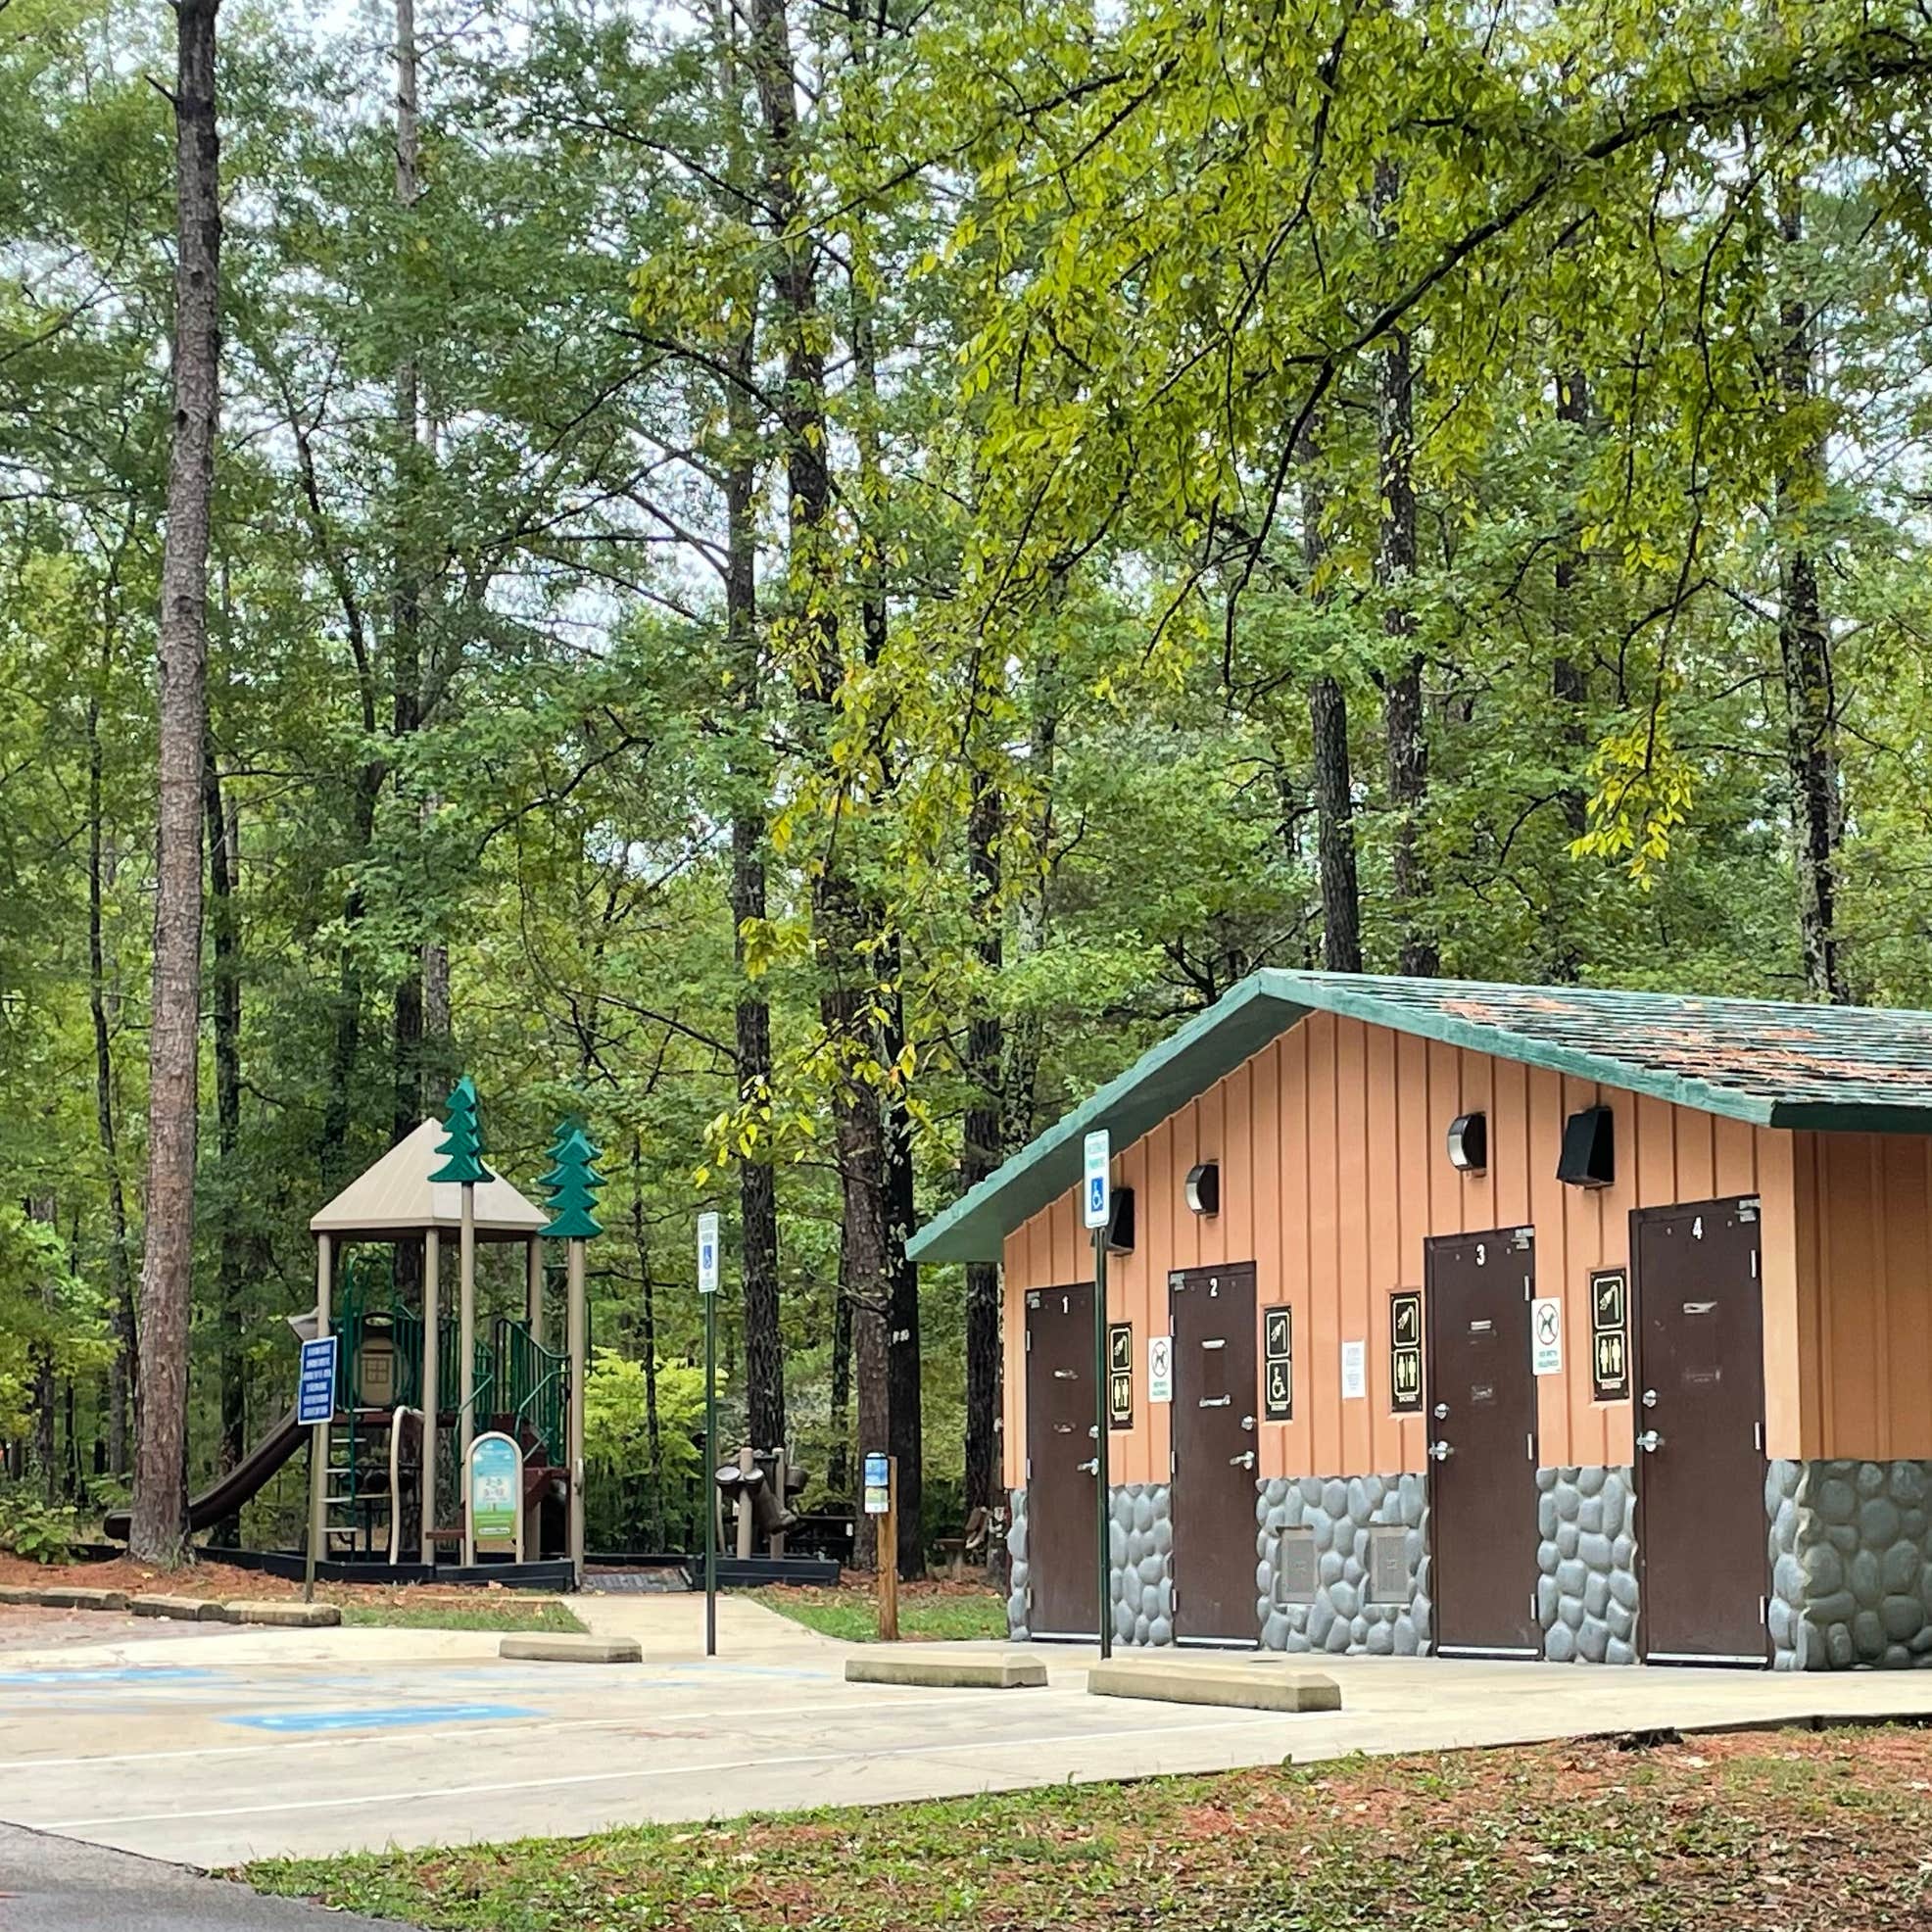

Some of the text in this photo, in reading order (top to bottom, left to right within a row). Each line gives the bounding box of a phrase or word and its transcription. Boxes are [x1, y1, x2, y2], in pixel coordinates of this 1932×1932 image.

[1692, 1216, 1703, 1240] 4
[1475, 1243, 1485, 1266] 3
[1210, 1277, 1218, 1297] 2
[1062, 1295, 1069, 1314] 1
